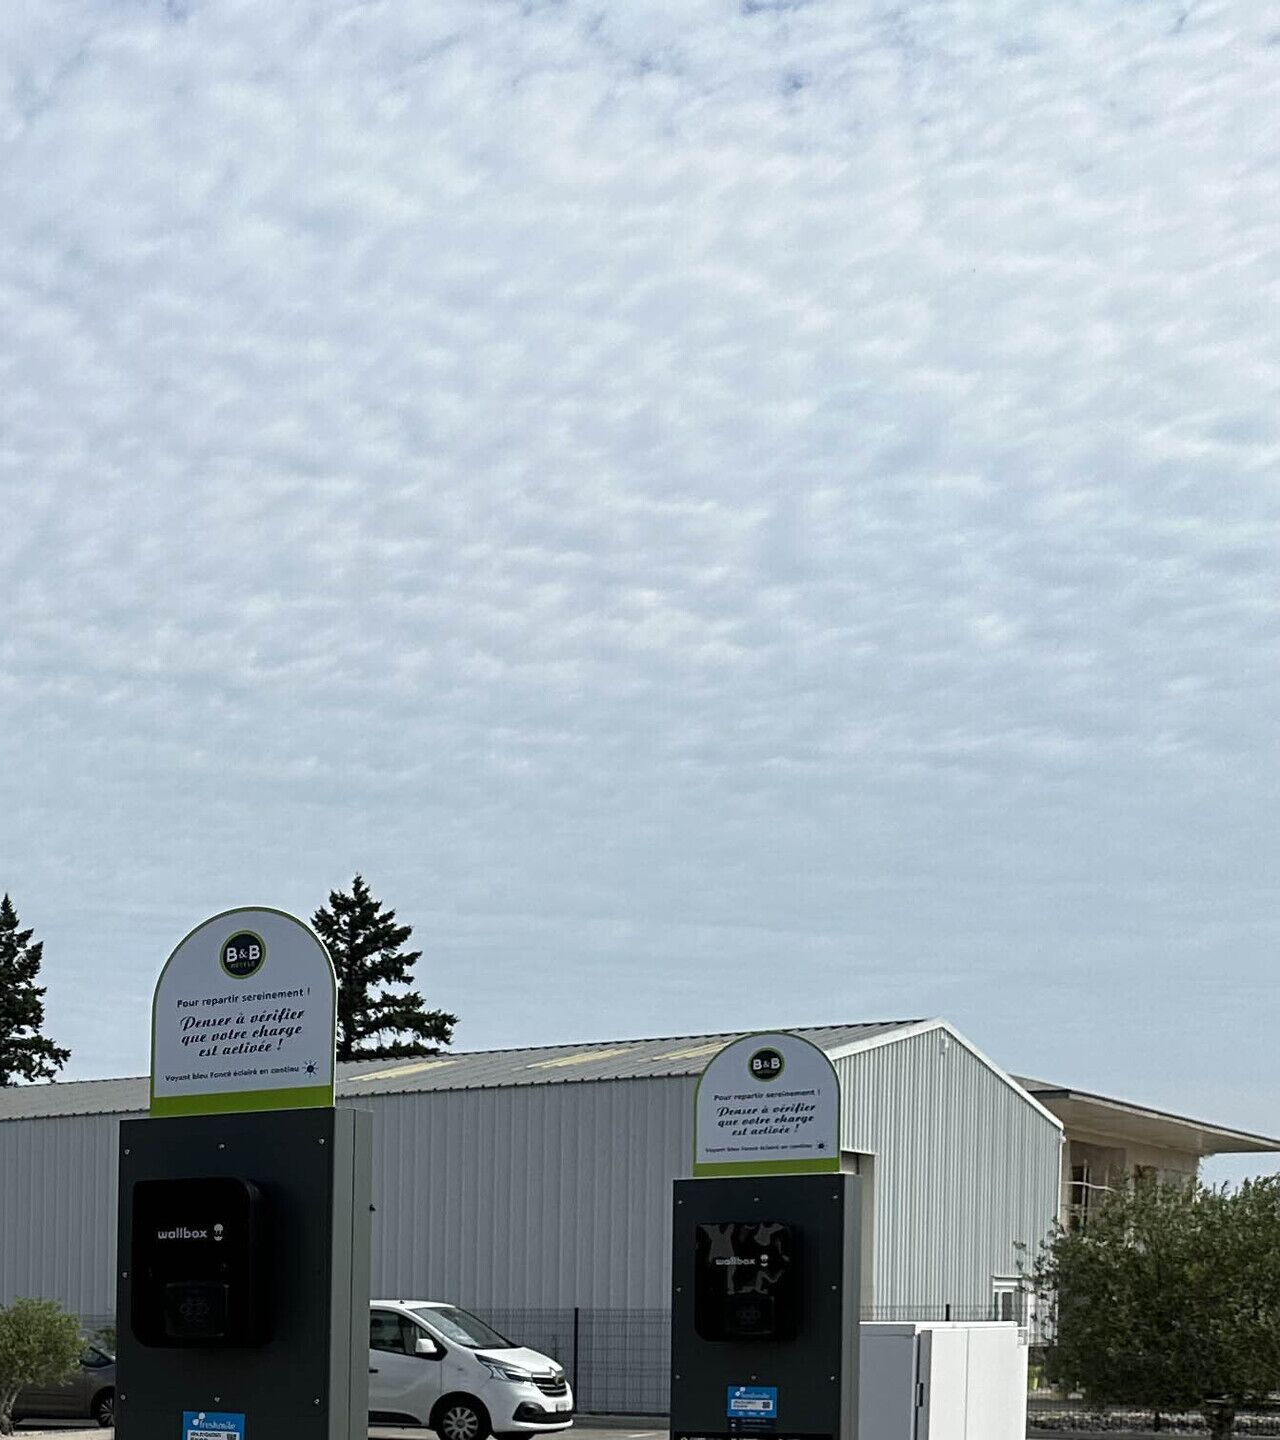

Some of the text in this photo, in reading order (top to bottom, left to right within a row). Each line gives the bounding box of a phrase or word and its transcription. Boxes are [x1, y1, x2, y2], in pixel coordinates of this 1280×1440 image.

[226, 945, 260, 963] B&B
[176, 999, 199, 1008] Pour
[202, 994, 239, 1007] repartir
[242, 988, 304, 1002] sereinement
[180, 1016, 232, 1031] Penser
[250, 1007, 305, 1023] vérifier
[181, 1024, 303, 1046] que votre charge
[198, 1045, 218, 1057] est
[222, 1040, 272, 1056] activée
[753, 1057, 780, 1070] B&B
[157, 1226, 207, 1239] wallbox
[715, 1257, 756, 1265] wallbox
